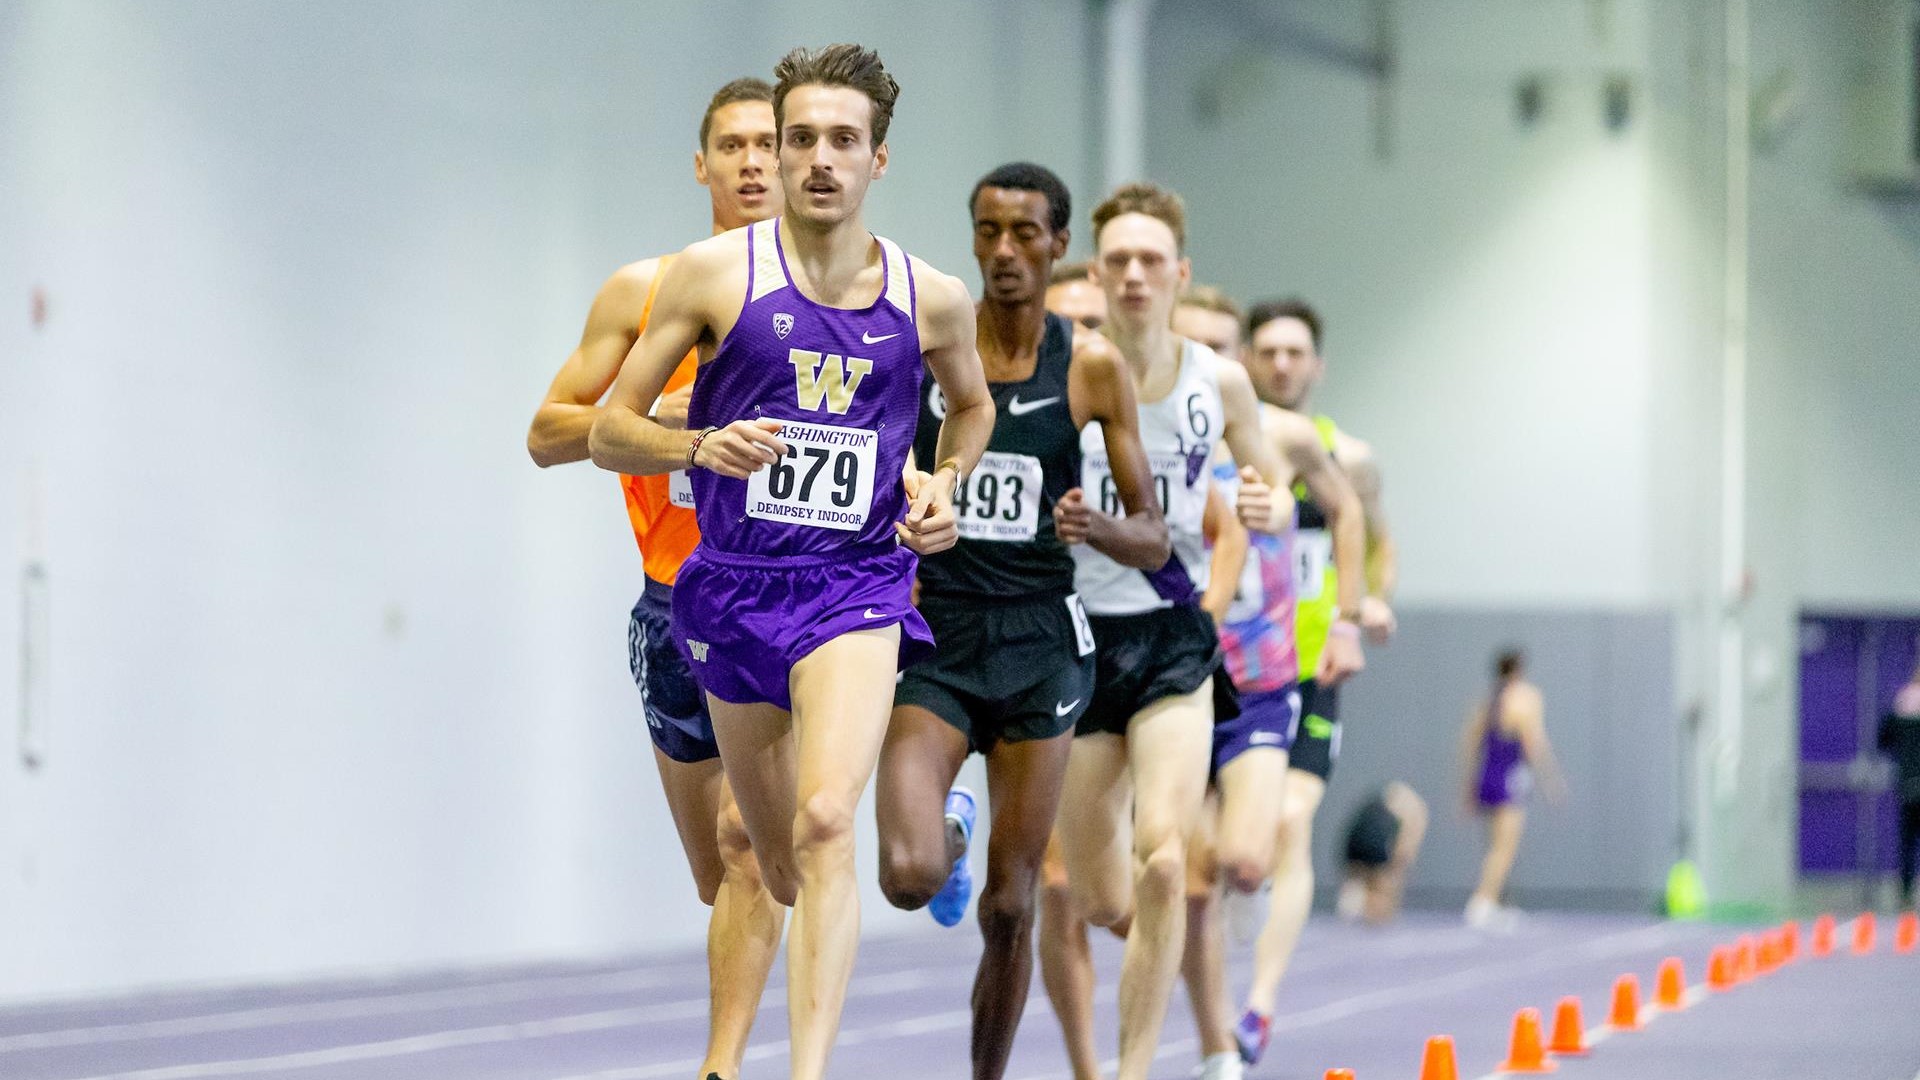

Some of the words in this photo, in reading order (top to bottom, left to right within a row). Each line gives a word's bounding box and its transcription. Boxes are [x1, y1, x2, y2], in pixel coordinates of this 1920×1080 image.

[776, 324, 788, 334] 12
[788, 347, 874, 416] W
[774, 425, 871, 447] ASHINGTON
[1187, 393, 1209, 438] 6
[768, 443, 859, 508] 679
[1101, 475, 1169, 517] 60
[757, 501, 815, 519] DEMPSEY
[817, 509, 862, 525] INDOOR
[952, 473, 1024, 522] 493
[686, 638, 710, 662] W
